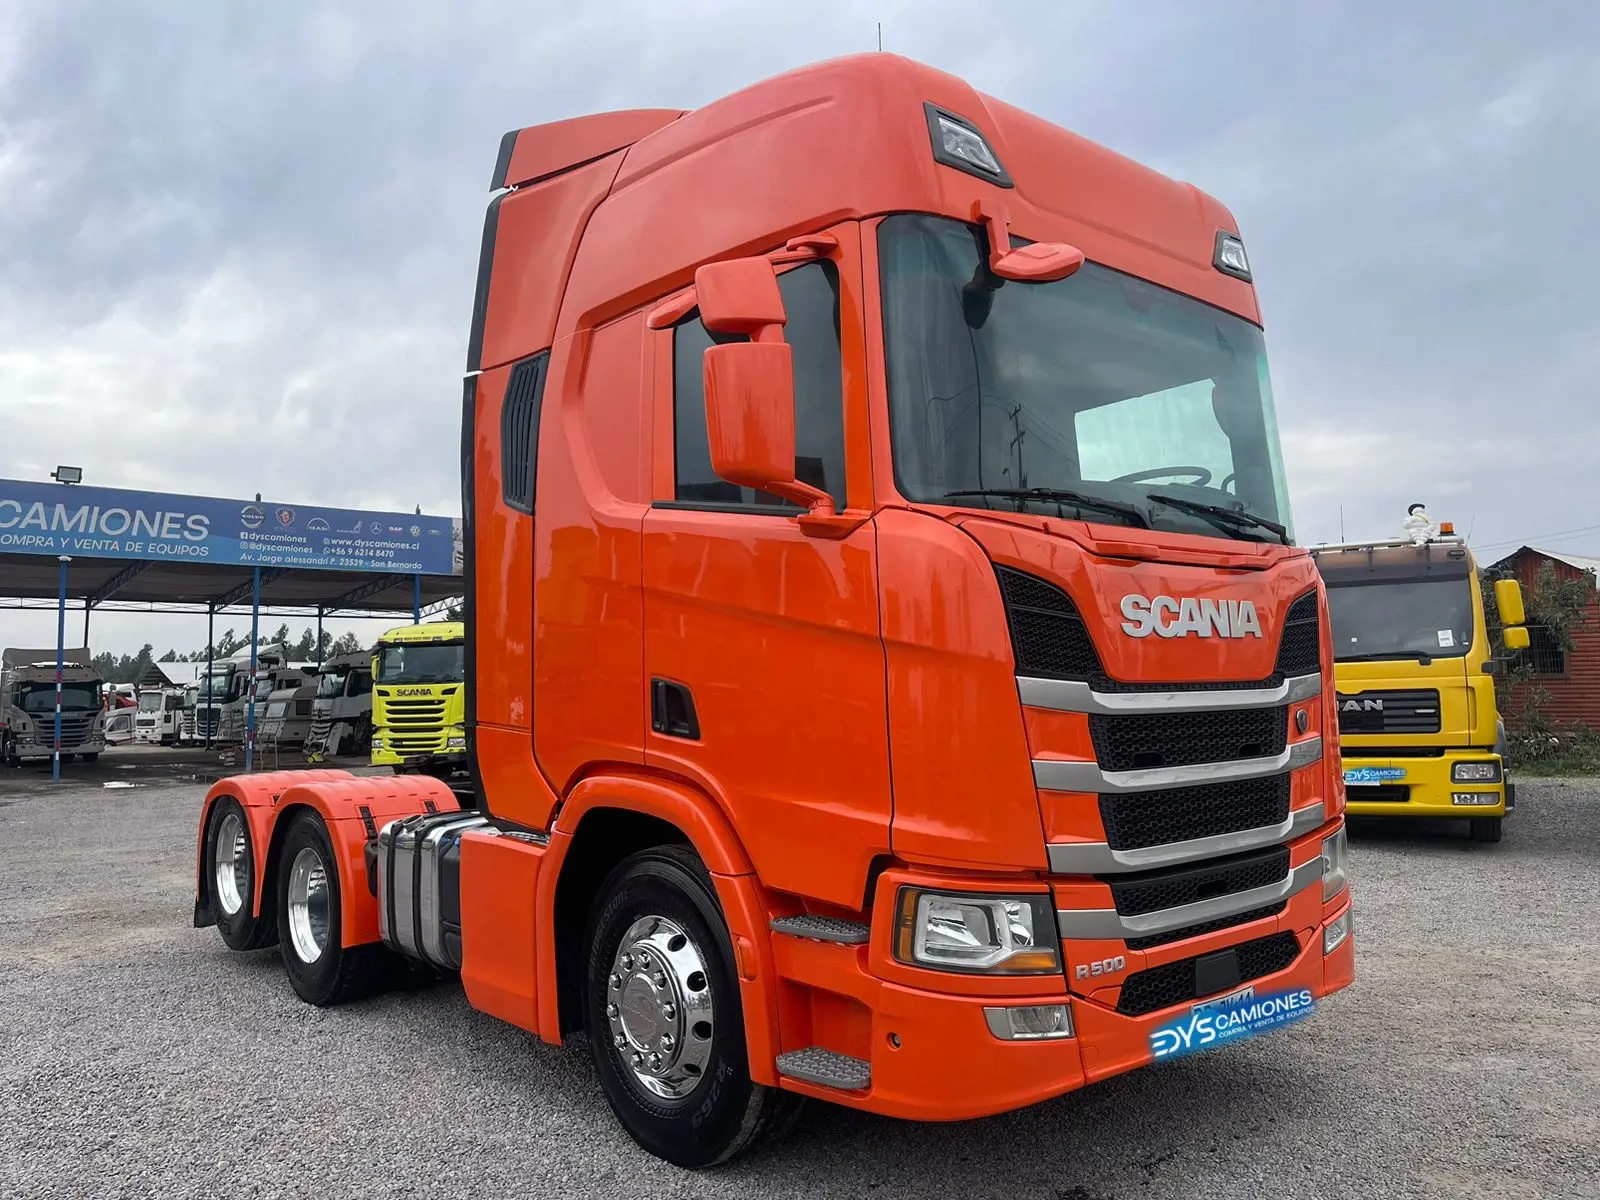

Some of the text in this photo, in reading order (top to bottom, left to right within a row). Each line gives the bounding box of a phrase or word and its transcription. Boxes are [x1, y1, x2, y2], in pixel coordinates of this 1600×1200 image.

[0, 500, 210, 541] CAMIONES
[0, 534, 209, 557] OMPRA Y VENTA DE EQUIPOS
[249, 532, 307, 544] dyscamiones
[331, 538, 420, 551] www.dyscamiones.cl
[331, 547, 346, 556] +56
[354, 548, 374, 557] 6214
[375, 550, 395, 558] 8470
[240, 553, 255, 562] Av.
[257, 554, 282, 564] Jorge
[370, 559, 386, 568] San
[387, 560, 423, 570] Bernardo
[1121, 594, 1263, 638] SCANIA
[396, 688, 432, 697] SCANIA
[1076, 955, 1126, 980] R 500
